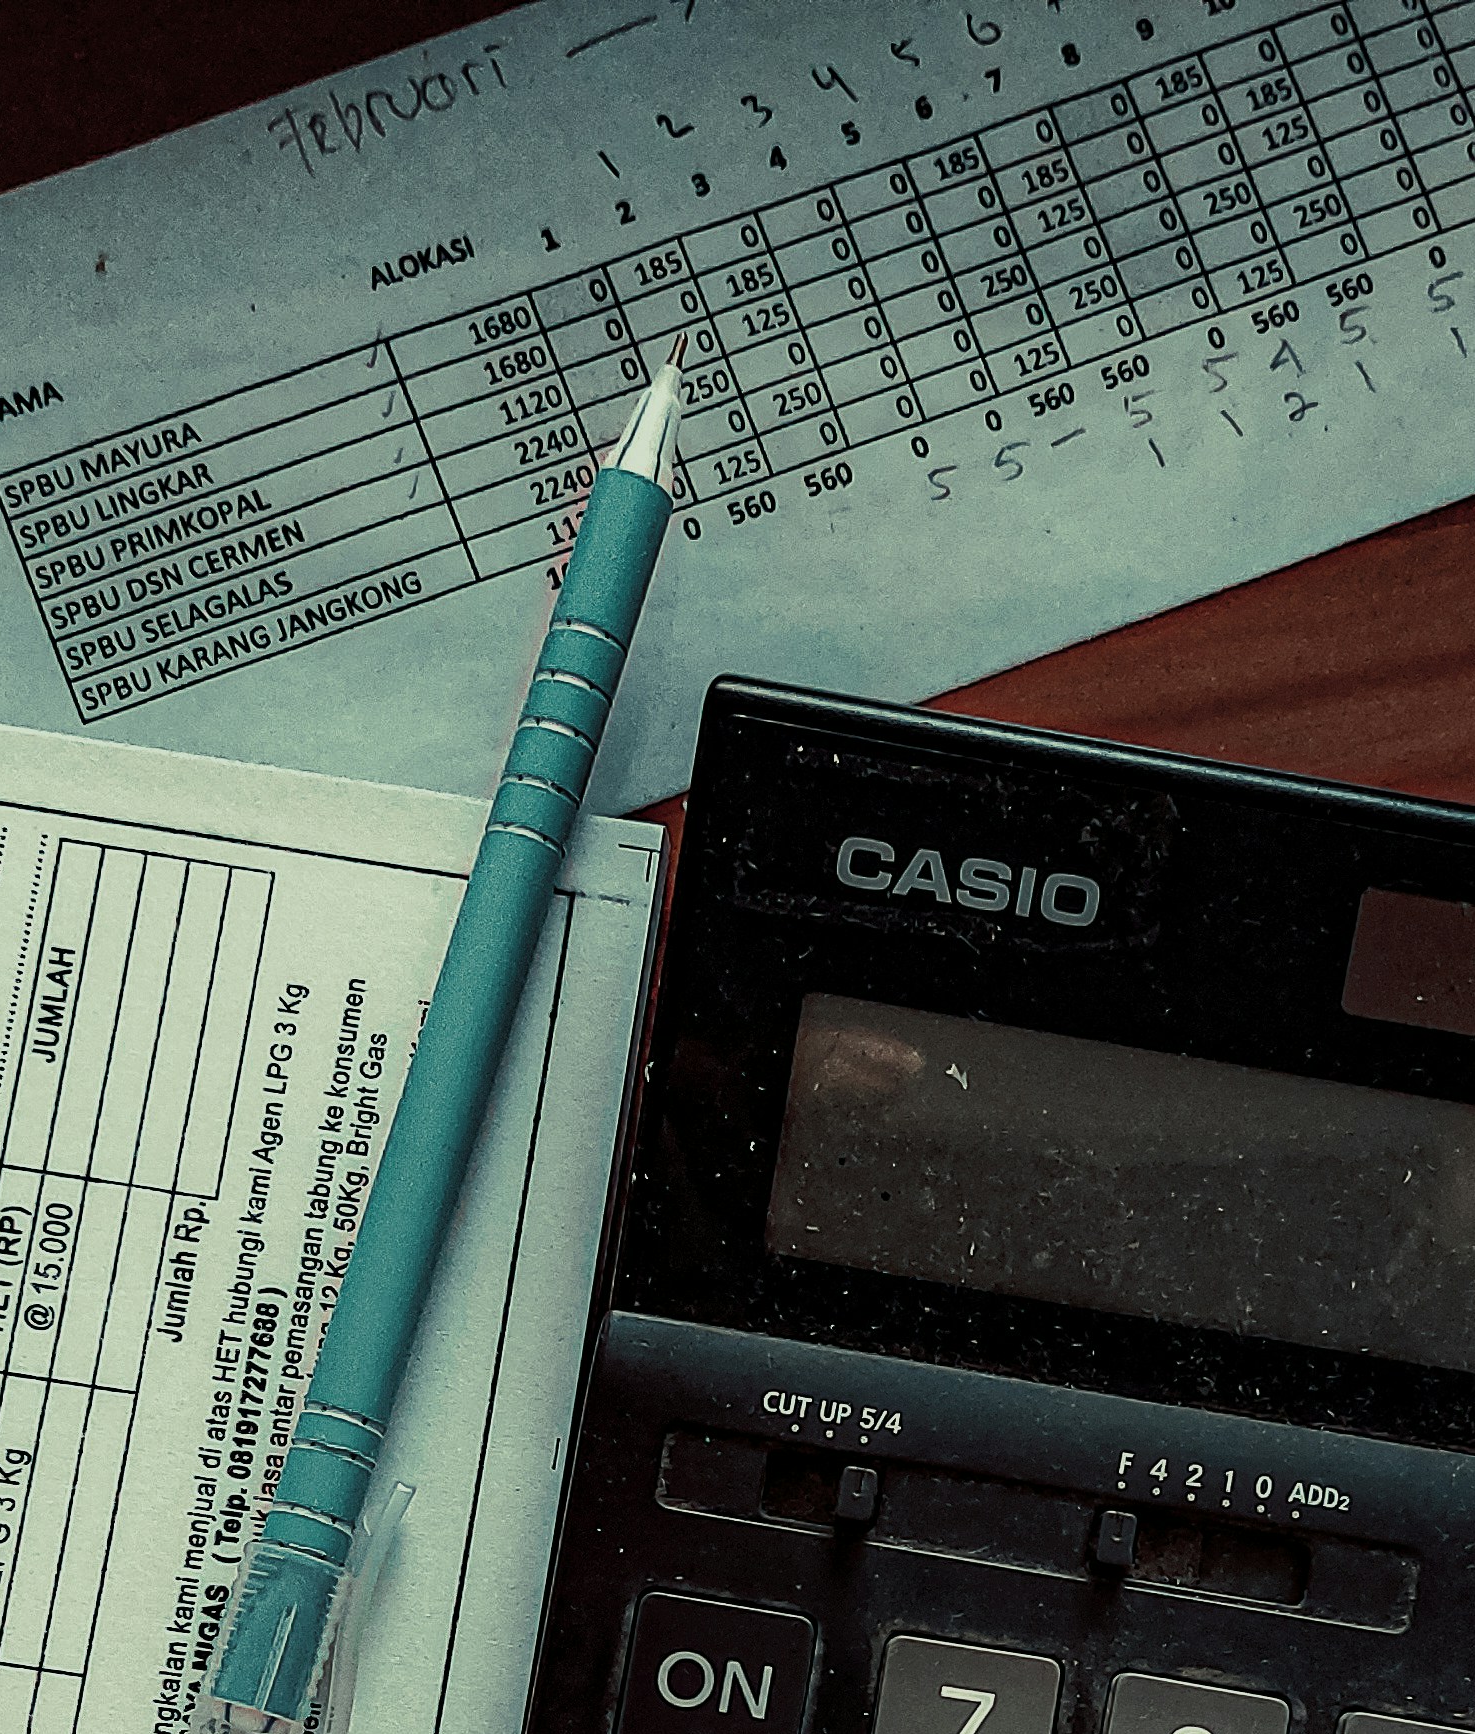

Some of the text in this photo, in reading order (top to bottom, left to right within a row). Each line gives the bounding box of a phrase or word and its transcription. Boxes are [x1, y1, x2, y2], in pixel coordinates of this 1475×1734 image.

[372, 235, 474, 290] ALOKASI
[469, 251, 682, 345] 1680 185
[484, 263, 773, 385] 1680 185
[499, 303, 789, 425] 1120 125
[515, 370, 729, 465] 2240 250
[530, 382, 821, 505] 2240 250
[5, 423, 202, 508] SPBU MAYURA
[20, 464, 214, 548] SPBU LINGKAR
[714, 450, 760, 485] 125
[727, 462, 852, 525] 560 560
[36, 490, 271, 589] SPBU PRIMKOPAL
[51, 520, 304, 629] SPBU DSN CERMEN
[66, 571, 292, 670] SPBU SELAGALAS
[82, 572, 421, 710] SPBU KARANG JANGKONG
[836, 837, 1100, 926] CASIO
[32, 947, 75, 1063] JUMLAH
[274, 1023, 296, 1035] 3
[278, 984, 309, 1014] Kg
[263, 1044, 292, 1094] LPG
[341, 1087, 379, 1156] Bright
[360, 1034, 387, 1079] Gas
[252, 1103, 283, 1164] Agen
[239, 1168, 271, 1224] kami
[270, 979, 365, 1446] antar pemasangan tabung ke konsumen
[31, 1203, 73, 1293] 15.000
[157, 1202, 210, 1342] Jumlah Rp.
[222, 1230, 264, 1324] hubungi
[24, 1304, 55, 1330] @
[212, 1330, 242, 1382] HET
[206, 1391, 232, 1441] atas
[764, 1392, 901, 1433] CUT UP 5/4
[198, 1447, 222, 1468] di
[1119, 1452, 1272, 1498] F 4 2 1 0
[184, 1476, 217, 1569] menjual
[214, 1488, 250, 1545] Telp.
[166, 1577, 199, 1633] kami
[658, 1651, 772, 1719] ON
